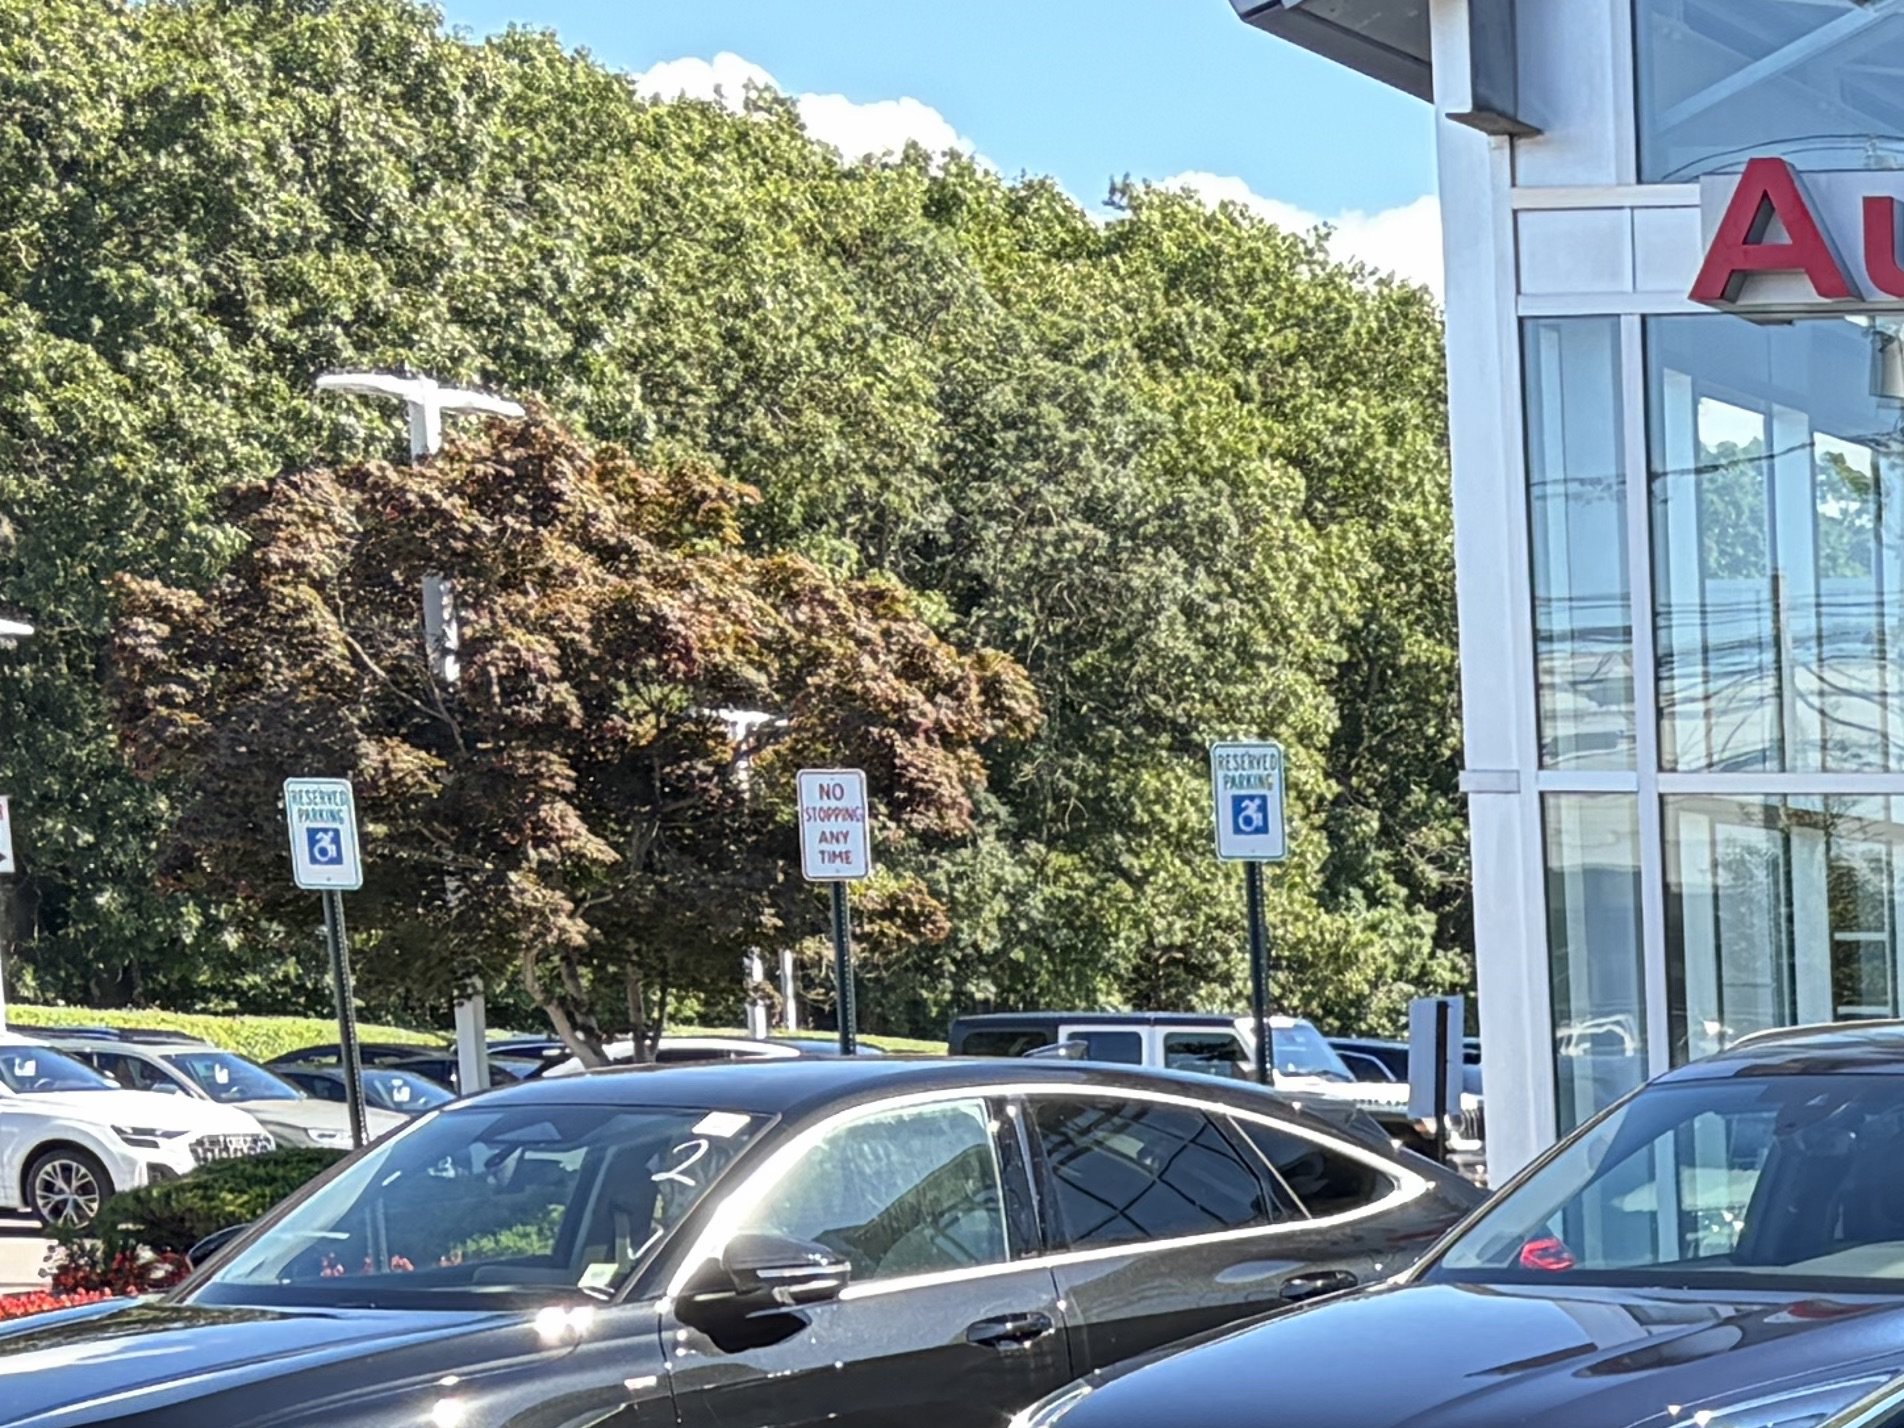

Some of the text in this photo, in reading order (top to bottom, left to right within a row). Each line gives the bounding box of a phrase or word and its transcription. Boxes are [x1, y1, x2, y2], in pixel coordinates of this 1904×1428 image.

[1217, 753, 1277, 772] RESERVED
[1223, 773, 1273, 791] PARKING
[290, 789, 348, 807] RESERVED
[819, 783, 845, 801] NO
[298, 807, 344, 824] PARKING
[805, 806, 865, 822] STOPPING
[818, 830, 850, 845] ANY
[819, 849, 853, 865] TIME
[651, 1139, 709, 1186] 2
